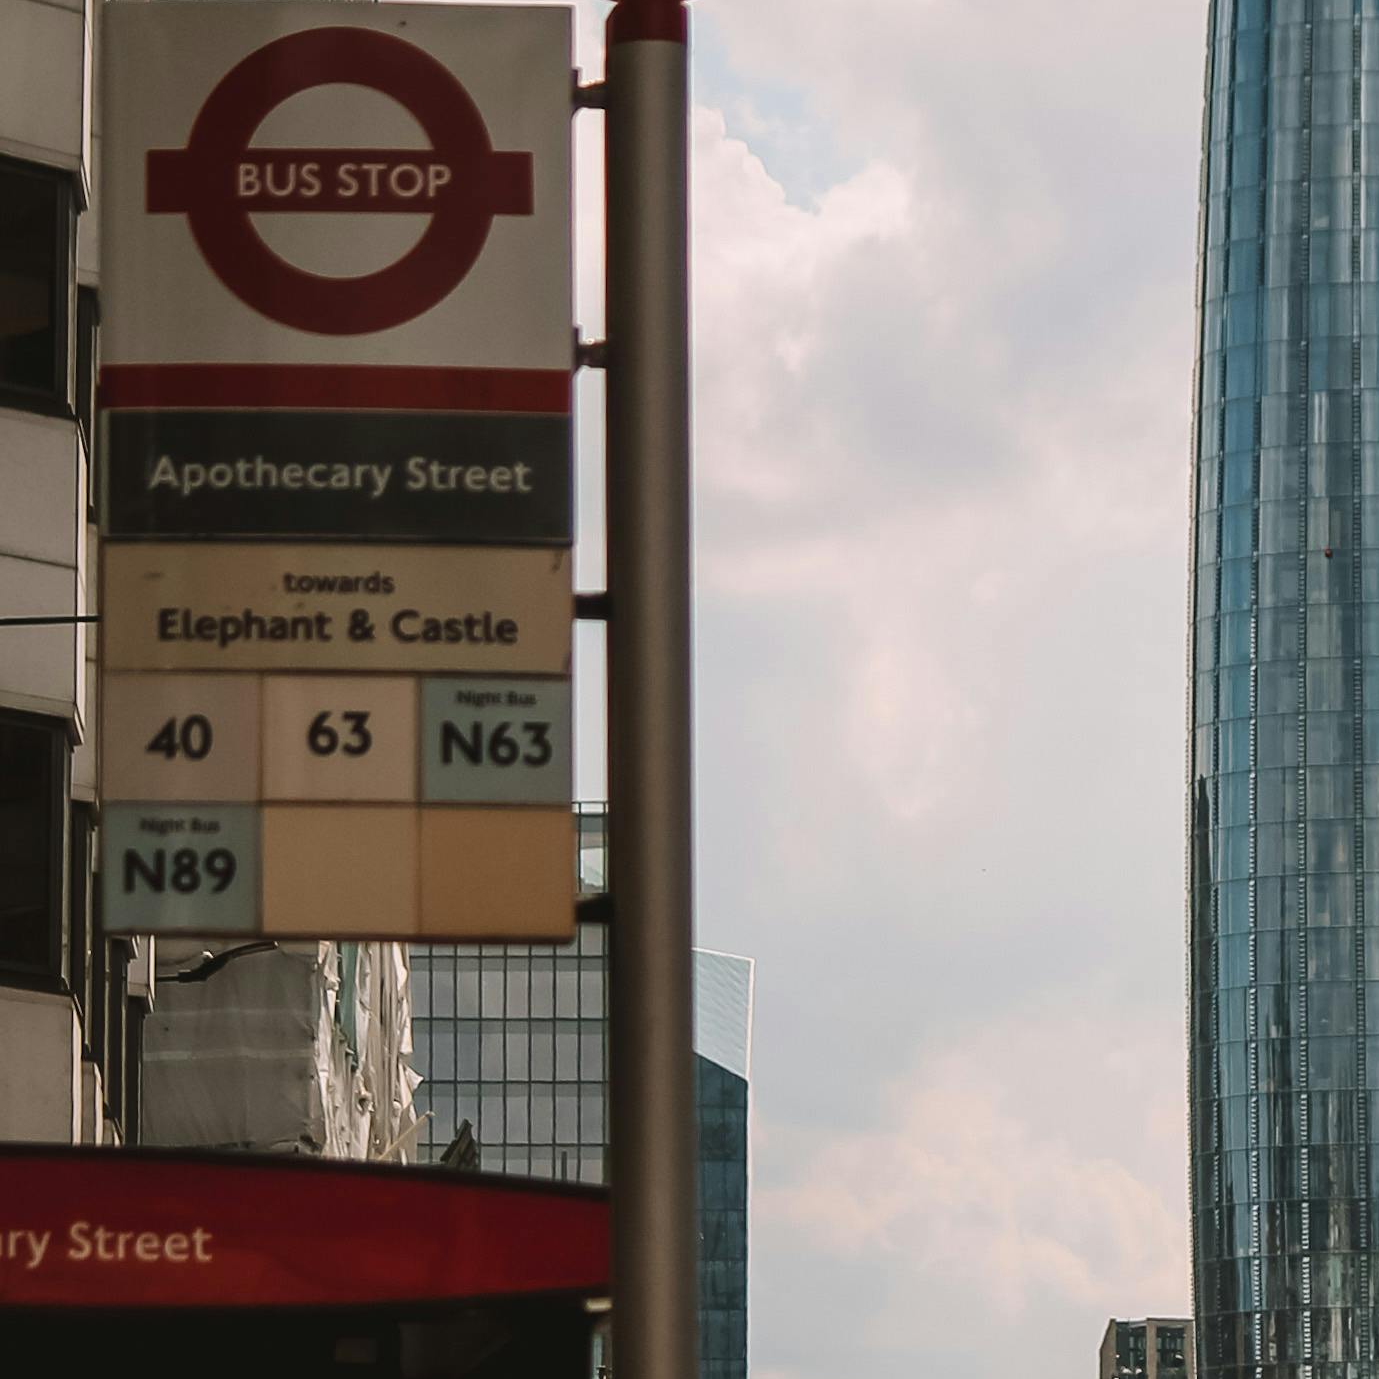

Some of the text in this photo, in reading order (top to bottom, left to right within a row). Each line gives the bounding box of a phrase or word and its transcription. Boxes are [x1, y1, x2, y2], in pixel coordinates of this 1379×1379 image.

[237, 163, 452, 199] BUS STOP
[148, 455, 532, 497] Apothecary Street
[284, 570, 395, 595] towards
[157, 608, 519, 648] Elephant & Castle
[456, 690, 537, 708] Night Bus
[145, 714, 213, 761] 40
[307, 710, 373, 757] 63
[440, 721, 553, 768] N63
[192, 818, 221, 833] Bus
[123, 847, 237, 895] N89
[67, 1219, 213, 1262] Street
